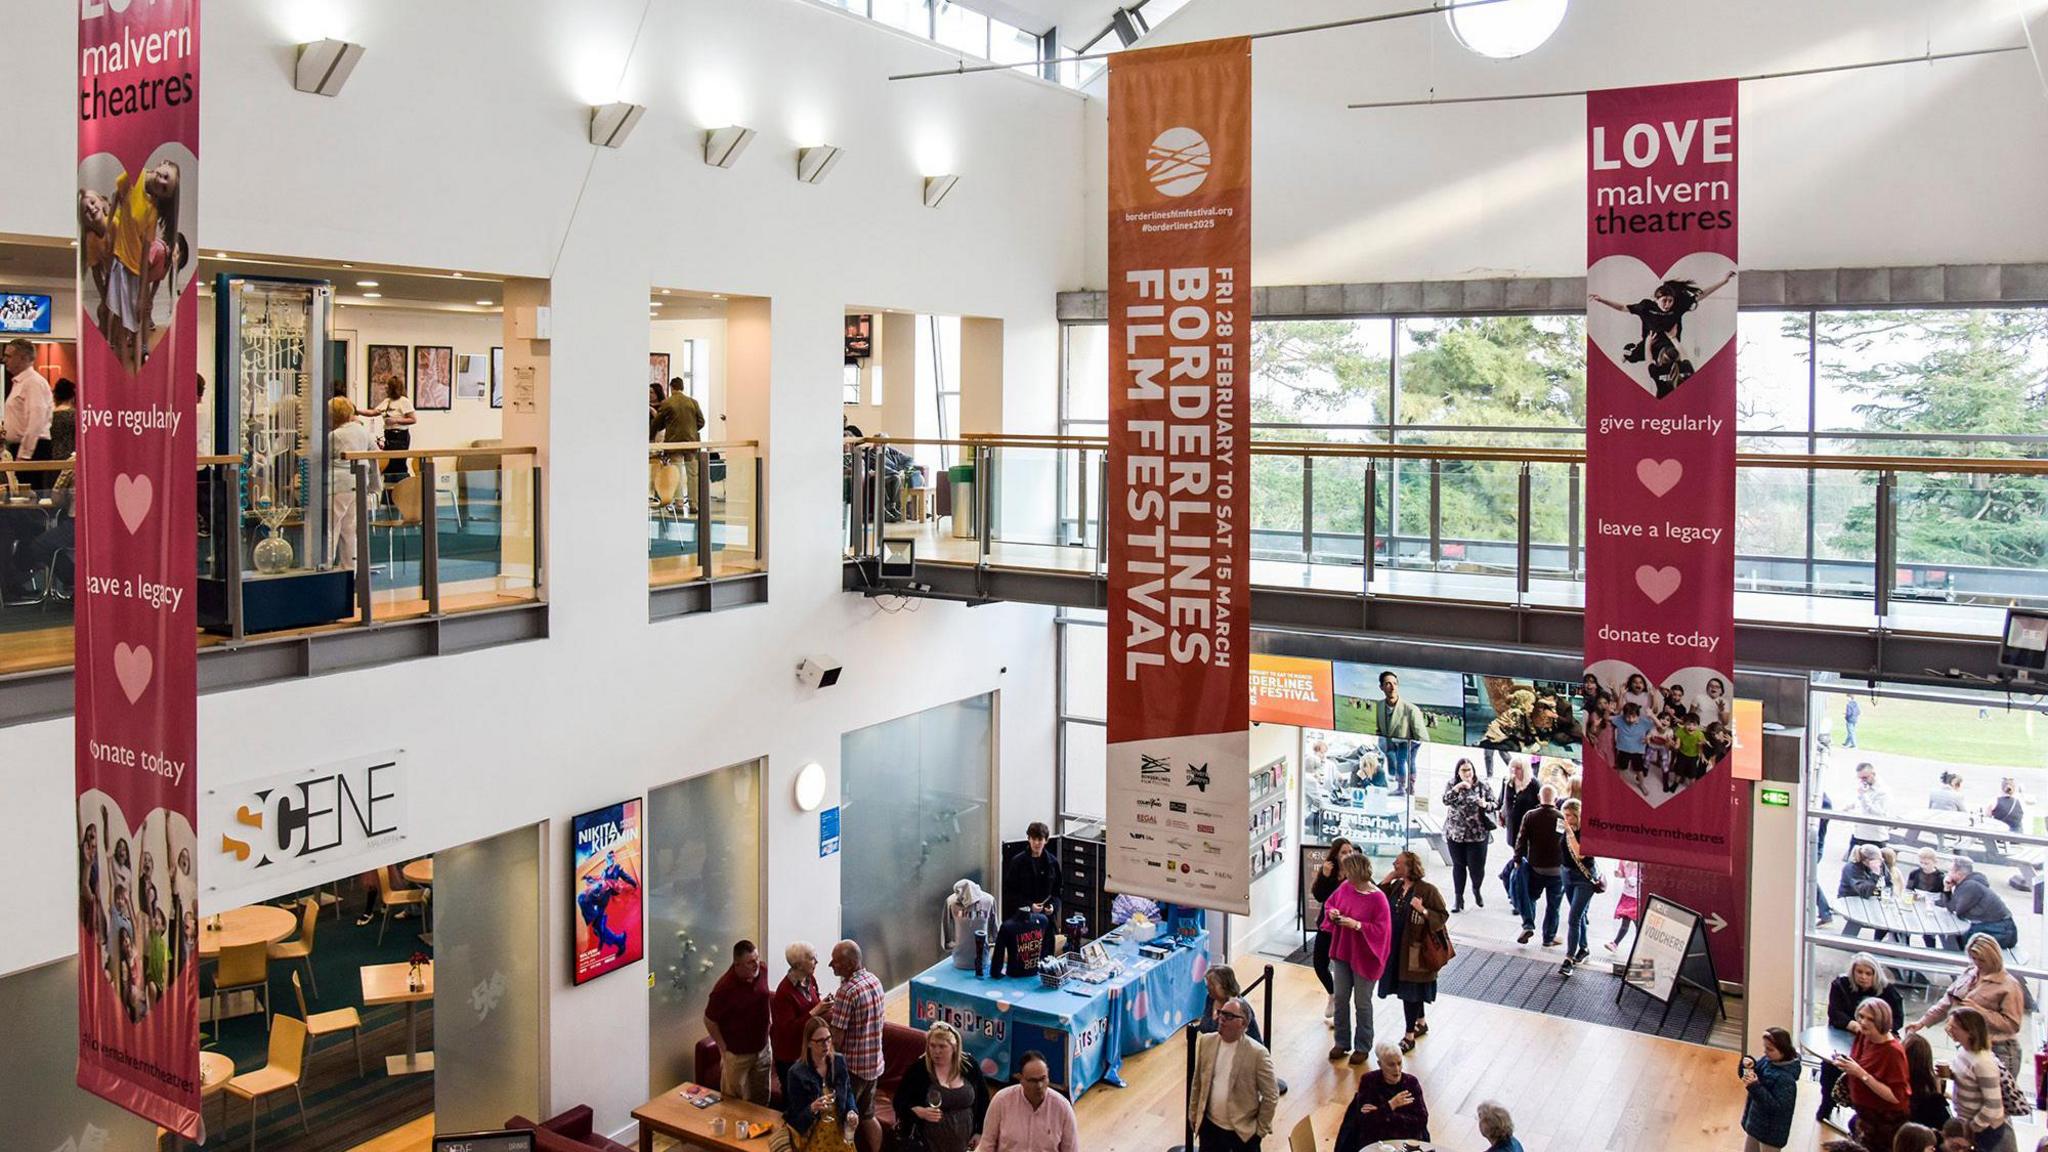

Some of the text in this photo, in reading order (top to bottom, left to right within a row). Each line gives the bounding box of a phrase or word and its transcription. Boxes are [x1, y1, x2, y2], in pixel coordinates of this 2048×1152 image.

[82, 25, 191, 77] malvern
[81, 72, 192, 120] theatres
[1592, 117, 1733, 171] LOVE
[1597, 176, 1729, 207] malvern
[1125, 206, 1233, 221] borderlinesfilmfestival.org
[1142, 219, 1215, 232] #borderlines2025
[1595, 206, 1732, 234] theatres
[82, 403, 113, 434] give
[1600, 414, 1722, 436] give regularly
[1126, 269, 1165, 681] FILM FESTIVAL
[1169, 267, 1211, 664] BORDERLINES
[1214, 267, 1233, 667] FRI 28 FEBRUARY TO SAT 15 MARCH
[1599, 518, 1722, 544] leave a legacy
[124, 580, 133, 598] a
[138, 574, 183, 613] legacy
[1598, 623, 1719, 652] donate today
[1249, 675, 1313, 691] DERLINES
[1260, 686, 1318, 702] FESTIVAL
[140, 750, 185, 787] today
[222, 761, 397, 868] SCENE
[578, 820, 618, 845] NIKITA
[591, 827, 639, 854] KUZMIN
[1588, 816, 1725, 845] #lovemalverntheatres
[1645, 924, 1686, 952] VOUCHERS
[917, 997, 1005, 1042] hairspray
